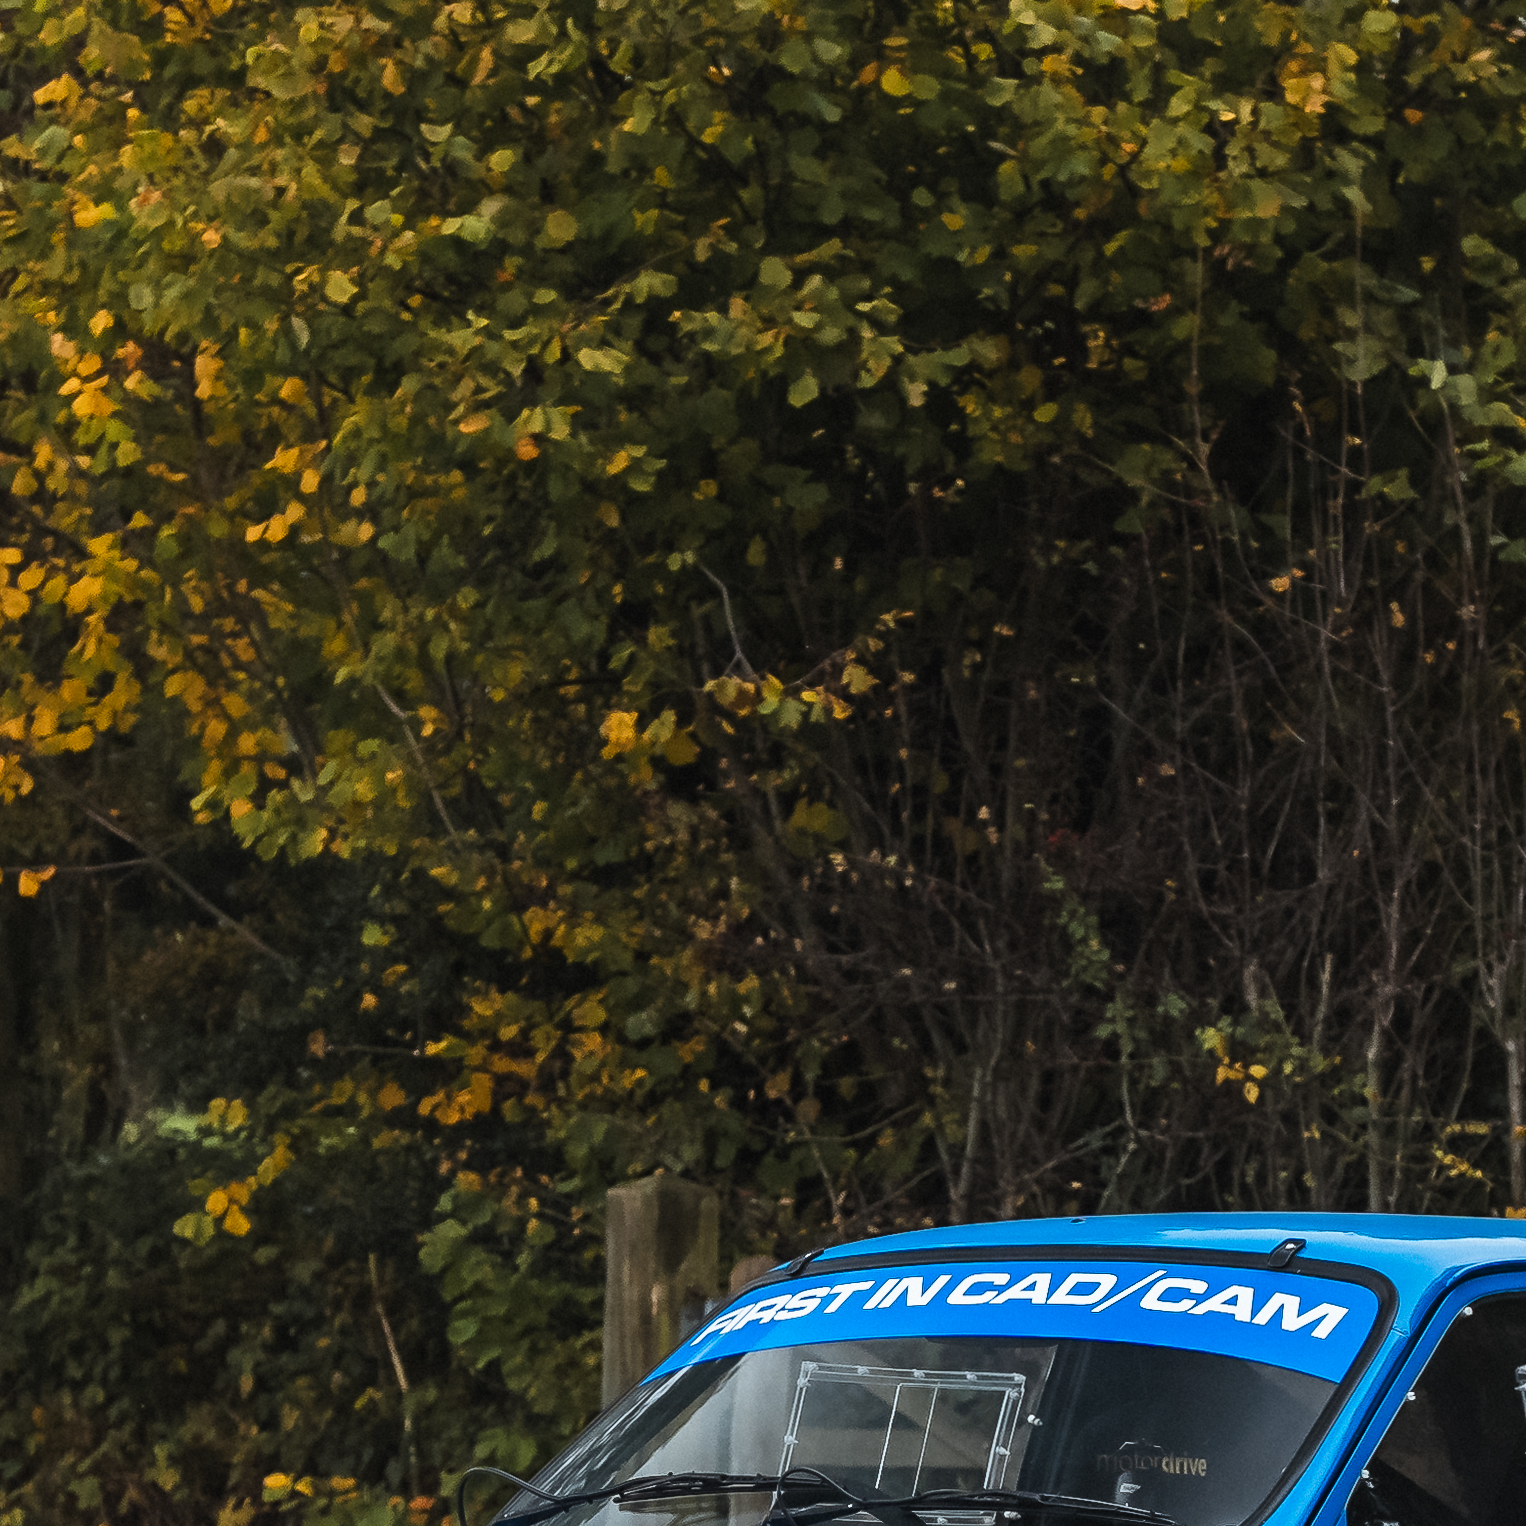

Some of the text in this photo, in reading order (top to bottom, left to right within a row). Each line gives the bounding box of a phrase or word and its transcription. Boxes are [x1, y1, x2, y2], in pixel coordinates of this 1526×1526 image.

[690, 1269, 1349, 1346] FIRST IN CAD/CAM
